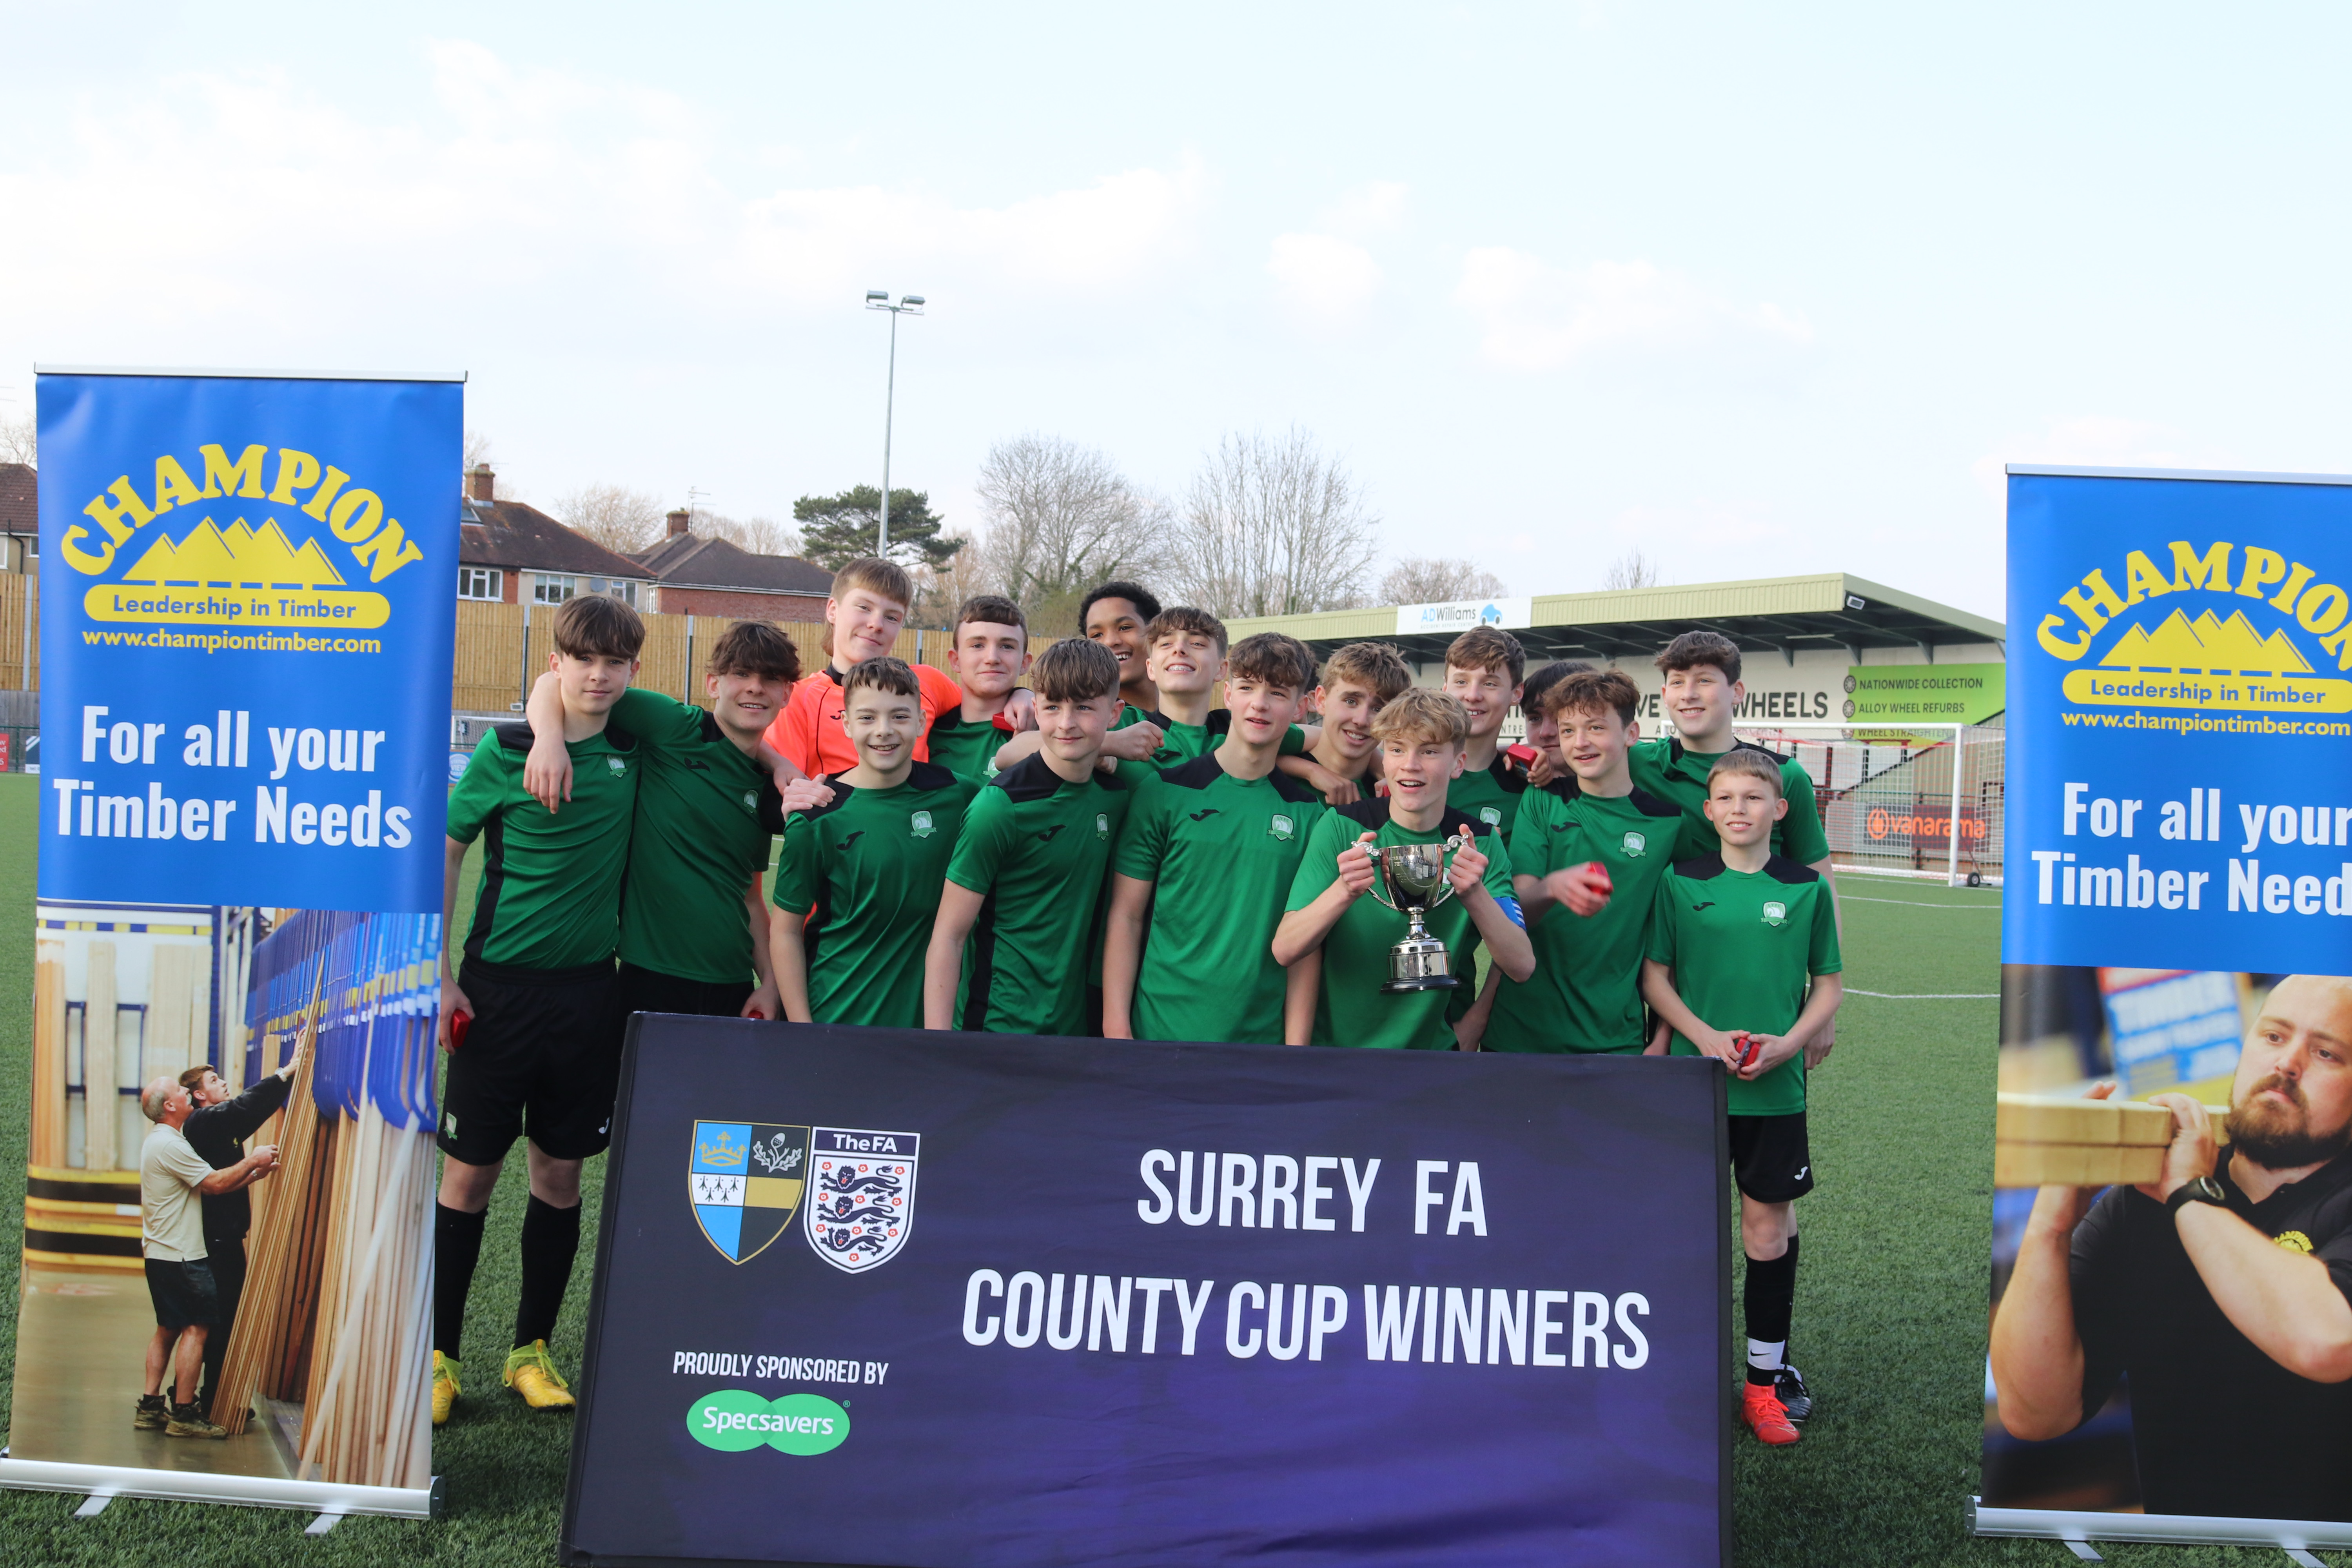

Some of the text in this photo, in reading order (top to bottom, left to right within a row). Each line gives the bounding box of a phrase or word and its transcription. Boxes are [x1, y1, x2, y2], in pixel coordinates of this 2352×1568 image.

[61, 444, 423, 583] CHAMPION
[113, 594, 357, 620] Leadership in Timber
[83, 628, 381, 653] www.championtimber.com
[1860, 678, 1983, 689] NATIONWIDE COLLECTION
[2091, 679, 2326, 704] Leadership in Timber
[1636, 692, 1828, 718] VE WHEELS
[1859, 703, 1964, 713] ALLOY WHEEL REFURBS
[1858, 729, 1887, 737] WHEEL
[2062, 711, 2350, 735] www.championtimber.com
[82, 705, 385, 780] For all your
[53, 778, 412, 849] Timber Needs
[1890, 815, 1985, 839] vanarama
[2063, 782, 2352, 853] For all your
[2031, 850, 2352, 916] Timber Need
[1137, 1149, 1488, 1237] SURREY FA
[962, 1269, 1650, 1370] COUNTY CUP WINNERS
[673, 1351, 889, 1385] PROUDLY SPONSORED BY
[702, 1406, 834, 1435] Specsavers
